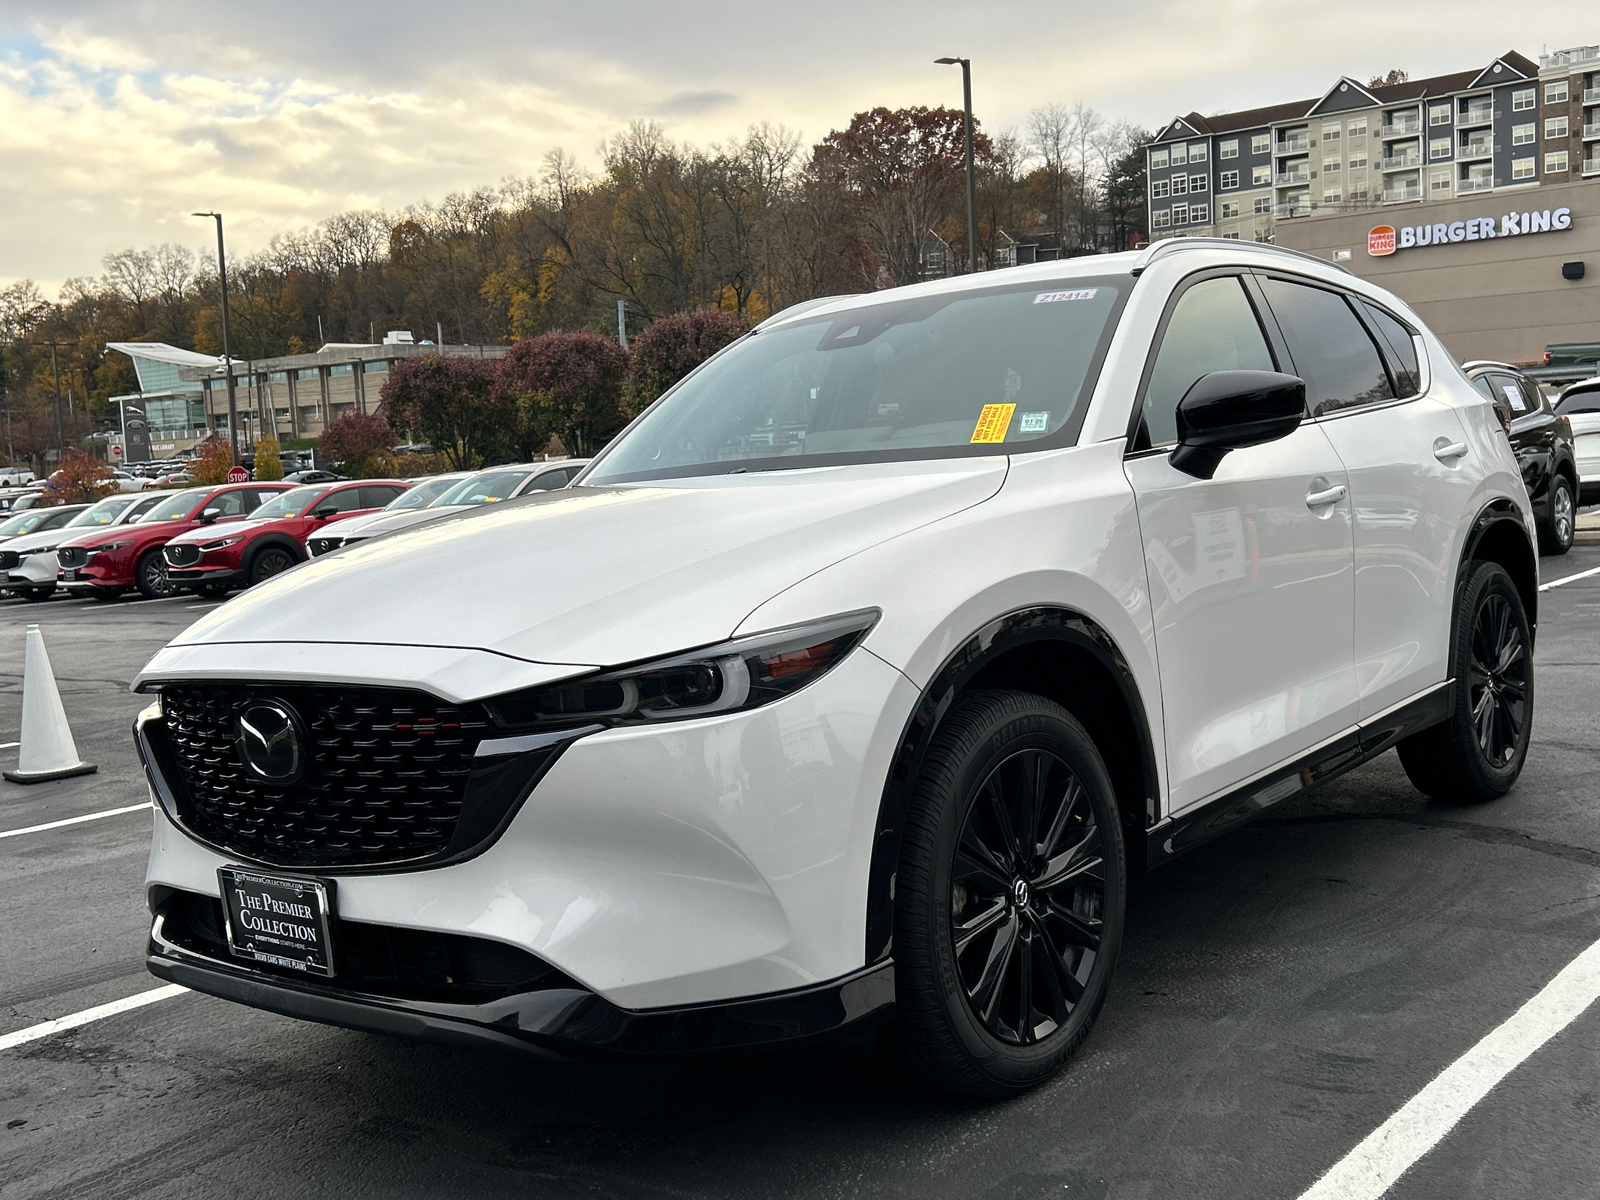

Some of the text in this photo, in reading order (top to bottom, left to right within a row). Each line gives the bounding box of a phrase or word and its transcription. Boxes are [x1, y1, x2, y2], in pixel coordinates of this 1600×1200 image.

[1369, 233, 1395, 241] BURGER
[1400, 207, 1571, 248] BURGER KING
[1369, 240, 1395, 250] KING
[973, 405, 993, 441] THIS VEHICLE
[229, 473, 247, 482] STOP
[235, 888, 314, 920] THE PREMIER
[240, 909, 317, 942] COLLECTION
